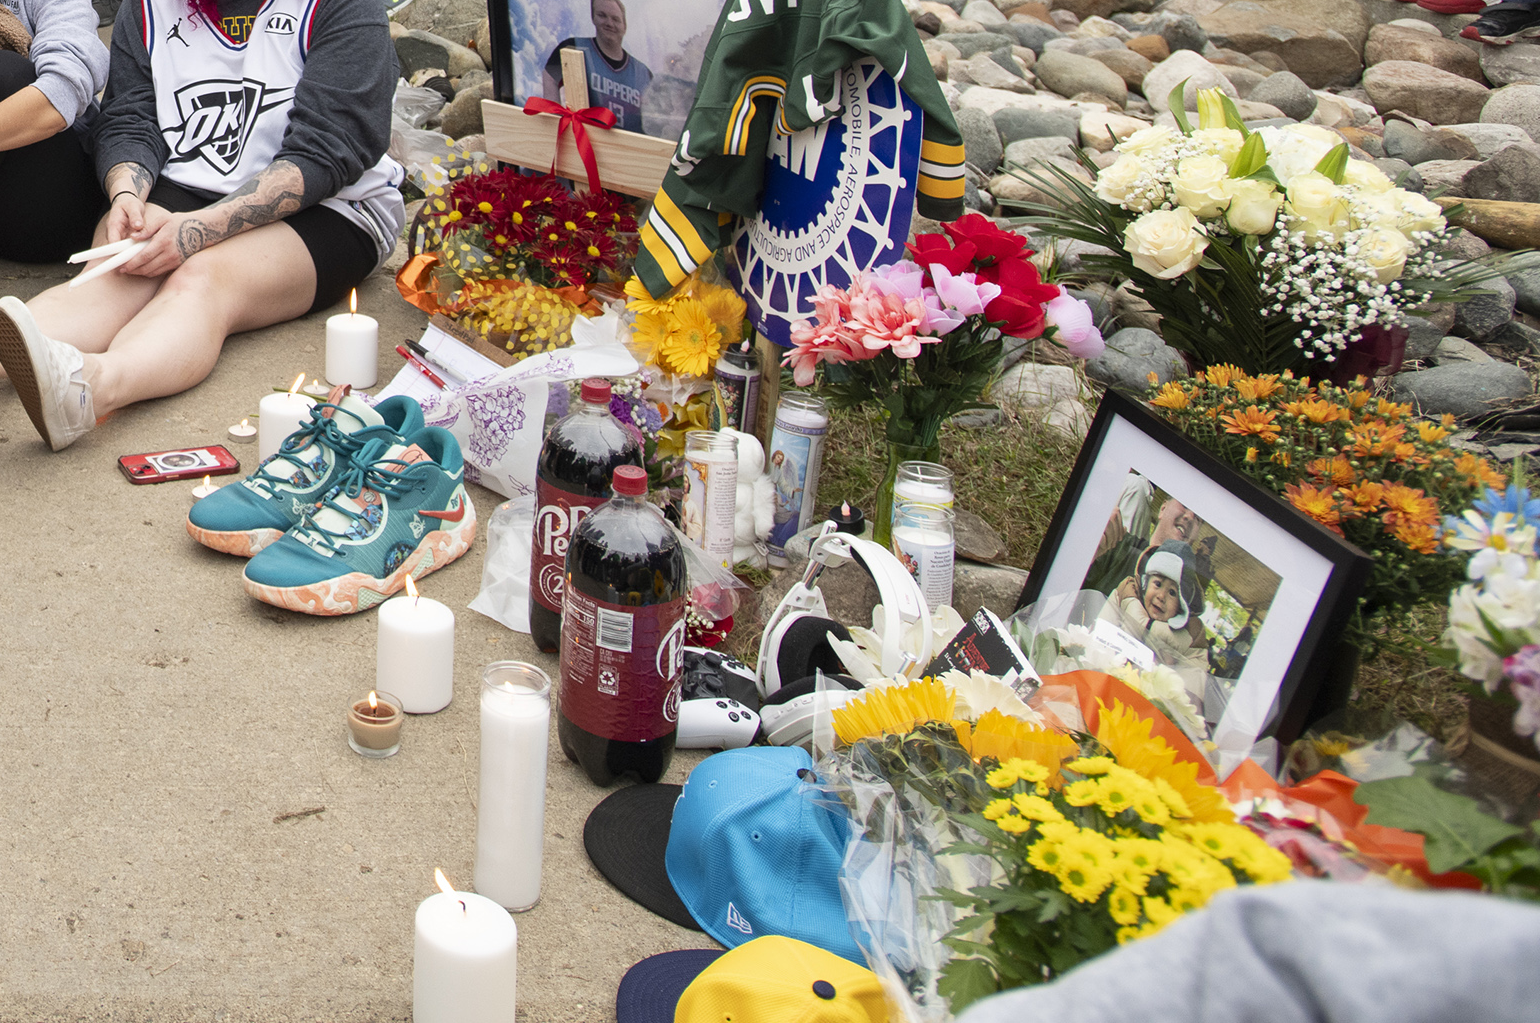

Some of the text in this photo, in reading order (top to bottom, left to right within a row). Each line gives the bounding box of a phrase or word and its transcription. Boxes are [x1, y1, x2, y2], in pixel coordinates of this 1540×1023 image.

[267, 17, 293, 31] KIA
[591, 72, 640, 108] CLIPPERS
[843, 63, 863, 158] TOMOBILE,
[766, 104, 830, 182] AW
[816, 166, 860, 249] AEROSPACE
[794, 239, 816, 262] AND
[553, 575, 563, 593] 2
